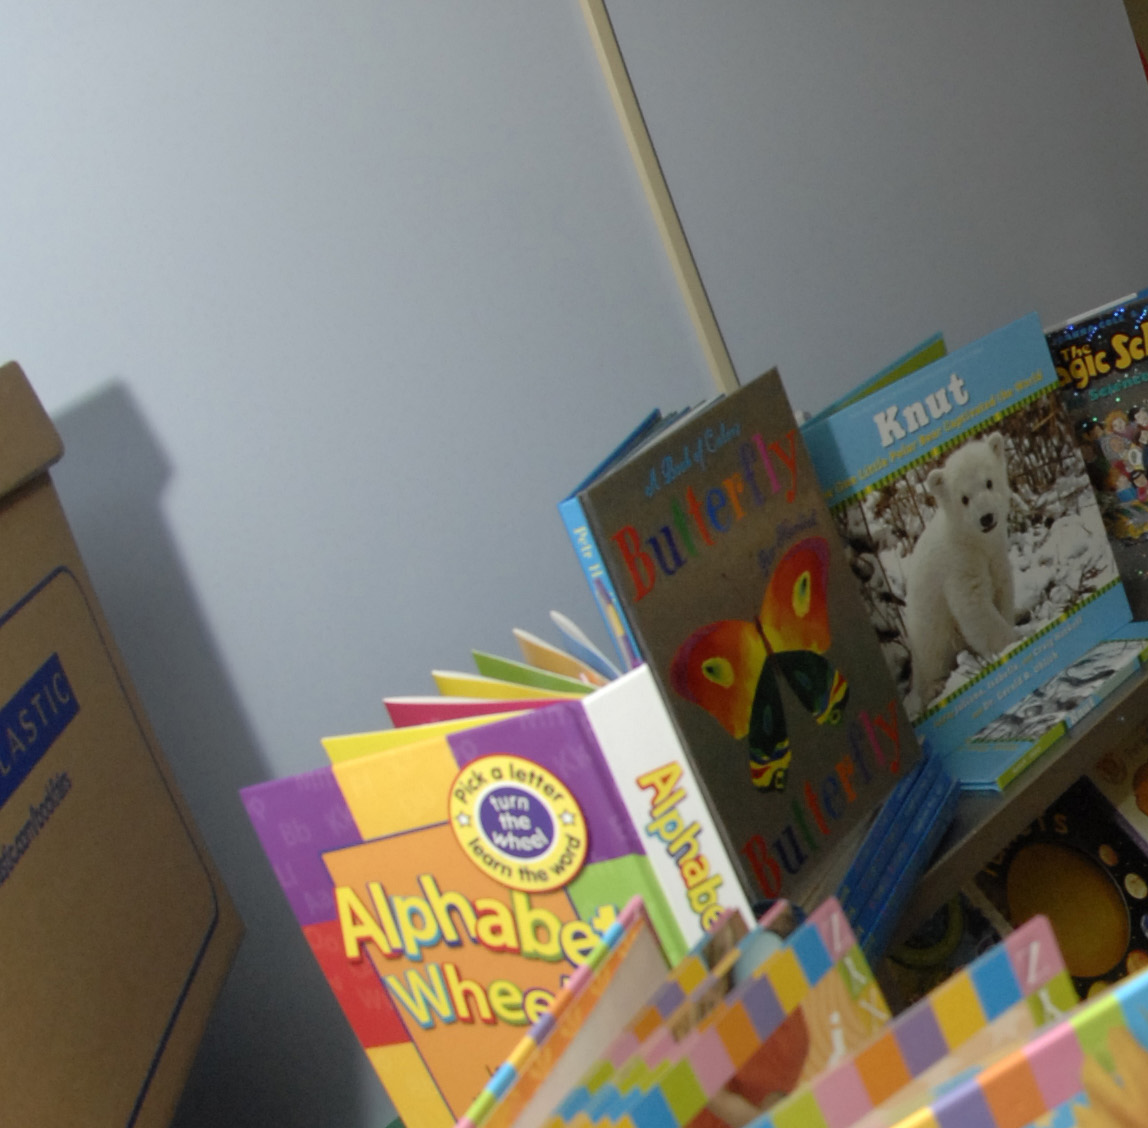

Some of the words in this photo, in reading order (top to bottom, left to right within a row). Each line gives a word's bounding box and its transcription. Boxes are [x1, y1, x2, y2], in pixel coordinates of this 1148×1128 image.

[1061, 343, 1091, 360] The
[872, 372, 970, 449] Knut
[611, 429, 798, 603] Butterfly
[454, 769, 488, 805] Pick
[491, 766, 503, 780] a
[509, 762, 565, 802] letter
[489, 794, 530, 812] turn
[741, 699, 900, 900] Butterfly
[491, 826, 550, 852] wheel
[498, 811, 532, 831] the
[468, 836, 513, 877] learn
[518, 866, 550, 882] the
[550, 833, 581, 876] word
[384, 962, 572, 1030] Whee
